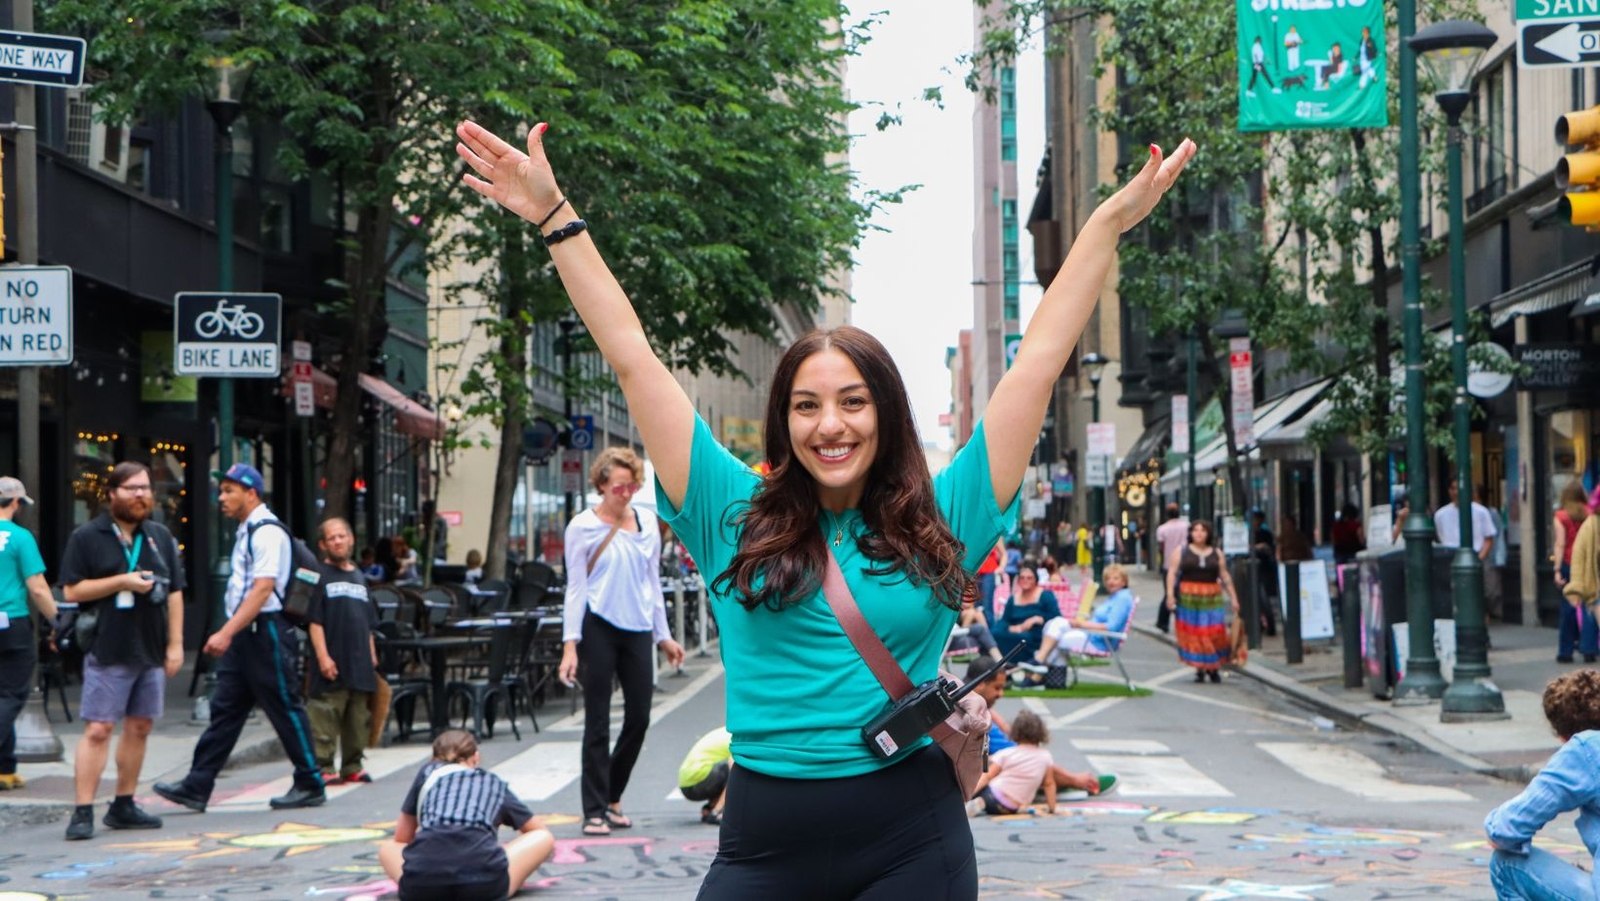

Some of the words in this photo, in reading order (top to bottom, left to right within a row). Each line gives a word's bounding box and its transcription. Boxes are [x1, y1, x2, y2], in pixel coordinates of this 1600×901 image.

[1580, 33, 1600, 50] O
[0, 46, 24, 66] NE
[32, 50, 67, 70] WAY
[7, 280, 39, 298] NO
[22, 333, 62, 351] RED
[183, 348, 220, 367] BIKE
[229, 349, 272, 368] LANE
[1521, 349, 1581, 361] MORTON
